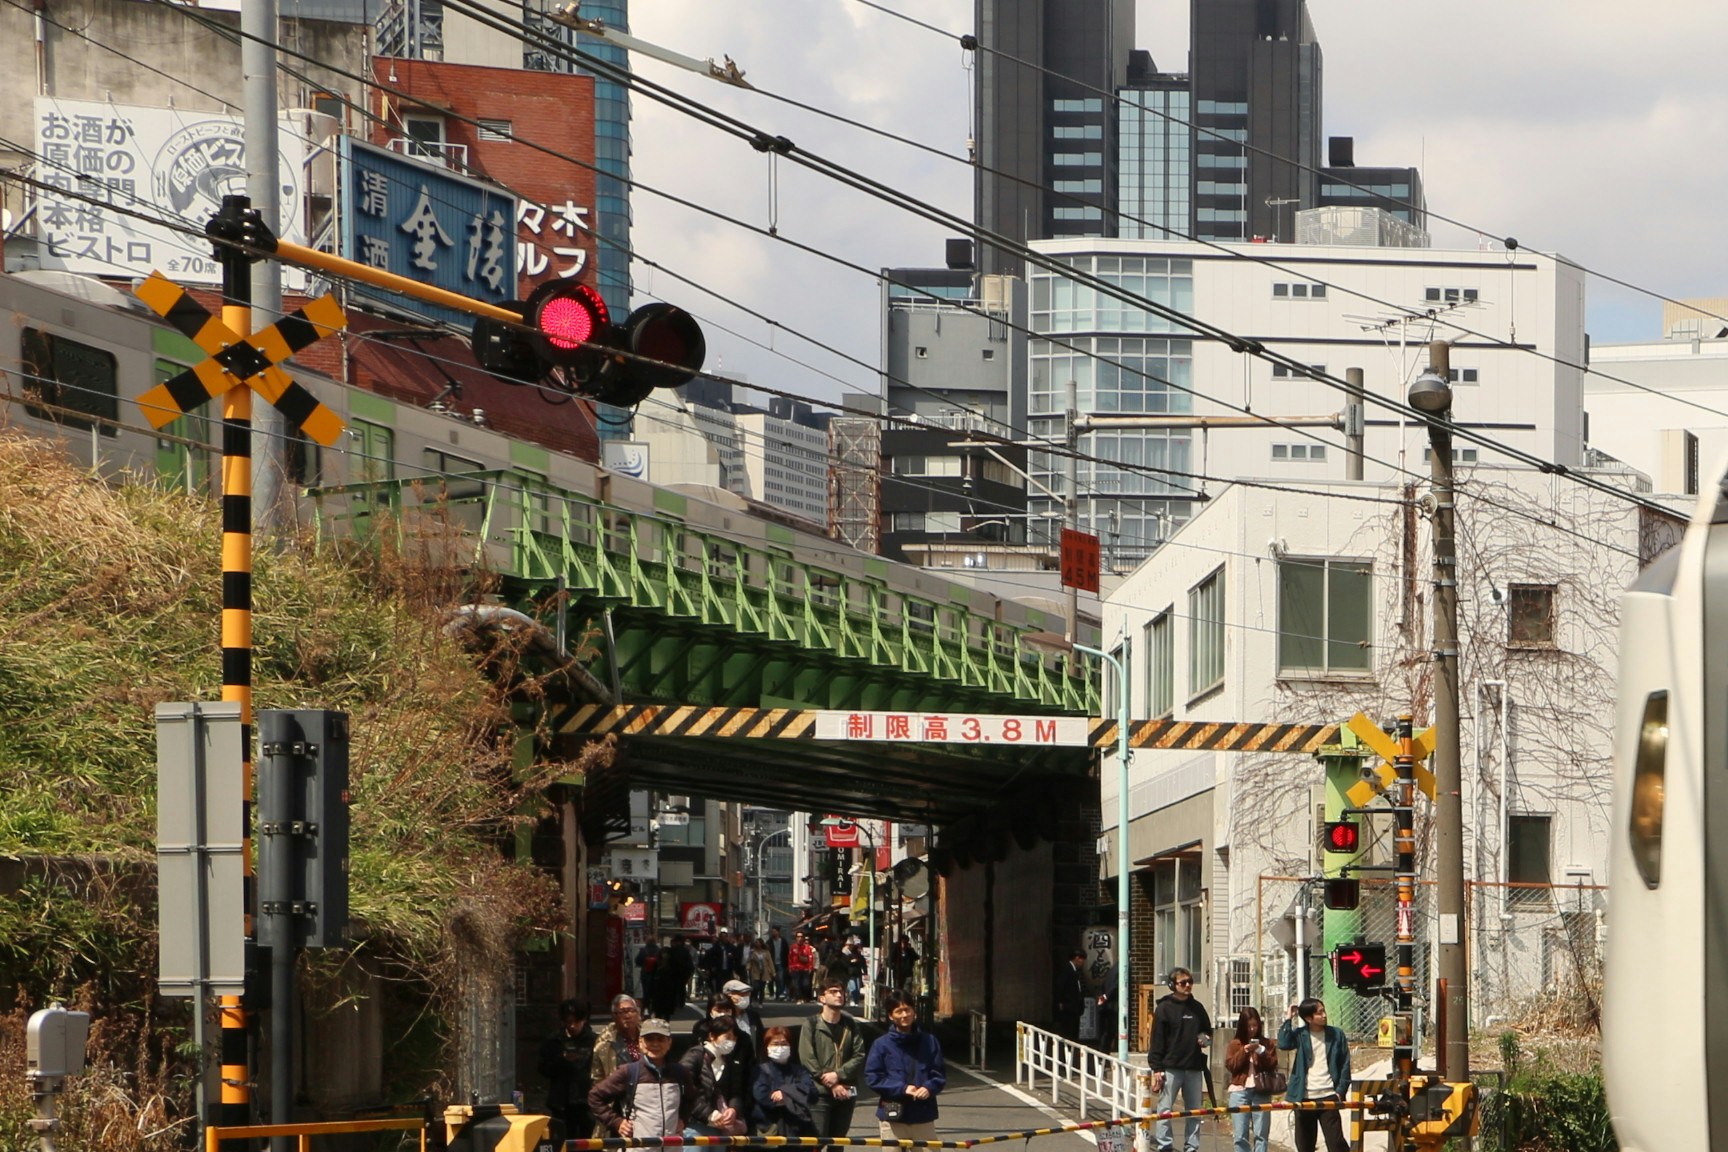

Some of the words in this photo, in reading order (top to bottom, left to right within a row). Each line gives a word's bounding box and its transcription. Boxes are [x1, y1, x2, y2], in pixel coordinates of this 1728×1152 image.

[41, 112, 135, 146] お酒が
[42, 142, 135, 176] 原価の
[43, 173, 135, 207] 肉専門
[43, 201, 105, 234] 本格
[361, 169, 389, 271] 清酒
[47, 232, 151, 264] ビストロ
[168, 256, 217, 275] 全70席
[847, 713, 1057, 743] 制限高3.8M
